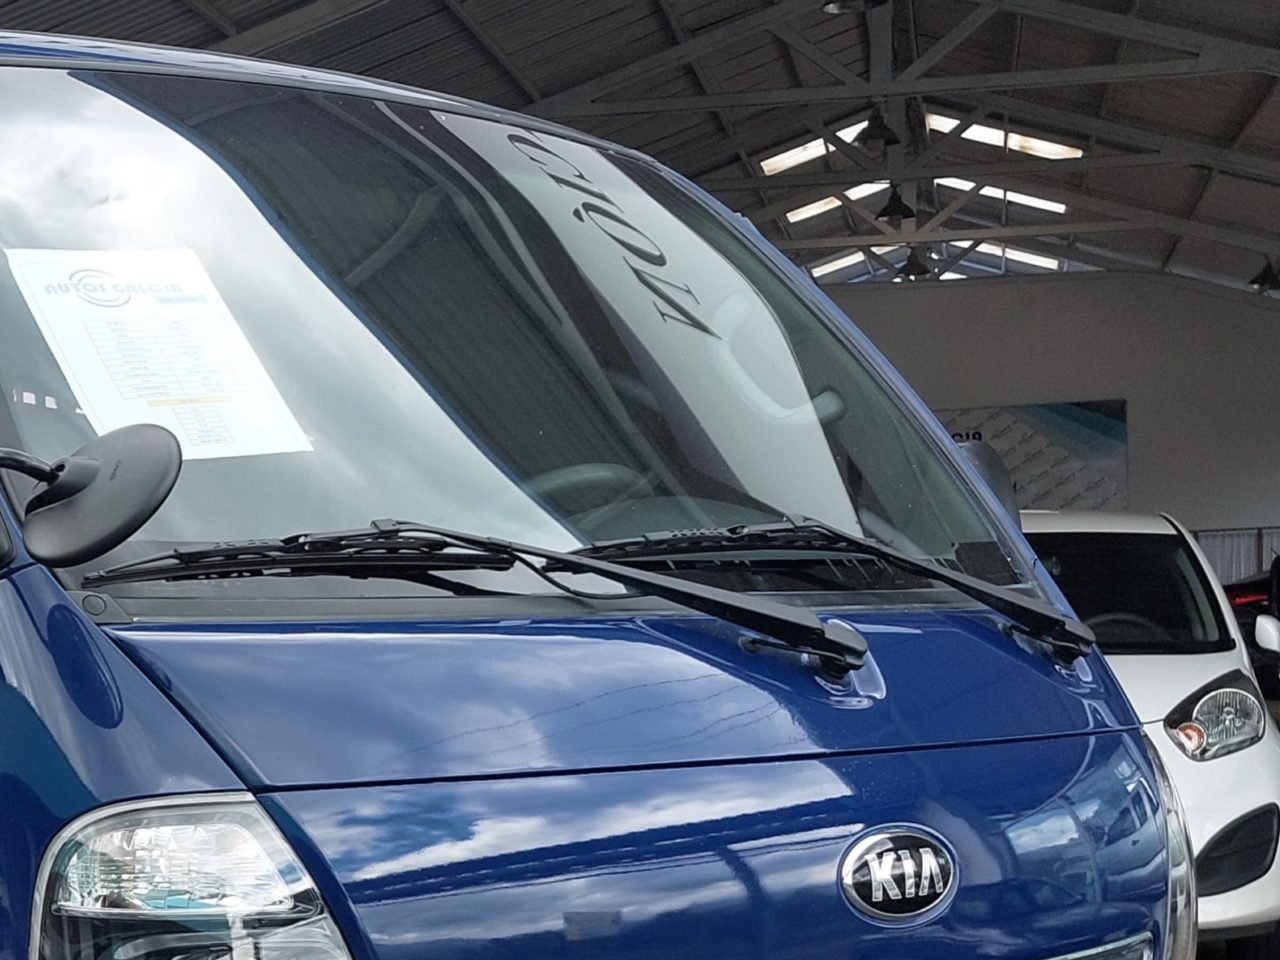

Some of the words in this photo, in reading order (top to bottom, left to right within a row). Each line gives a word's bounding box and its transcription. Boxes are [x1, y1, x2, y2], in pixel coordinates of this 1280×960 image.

[44, 282, 107, 296] AUTOS
[112, 282, 184, 295] GRECIA
[864, 847, 944, 902] KIA
